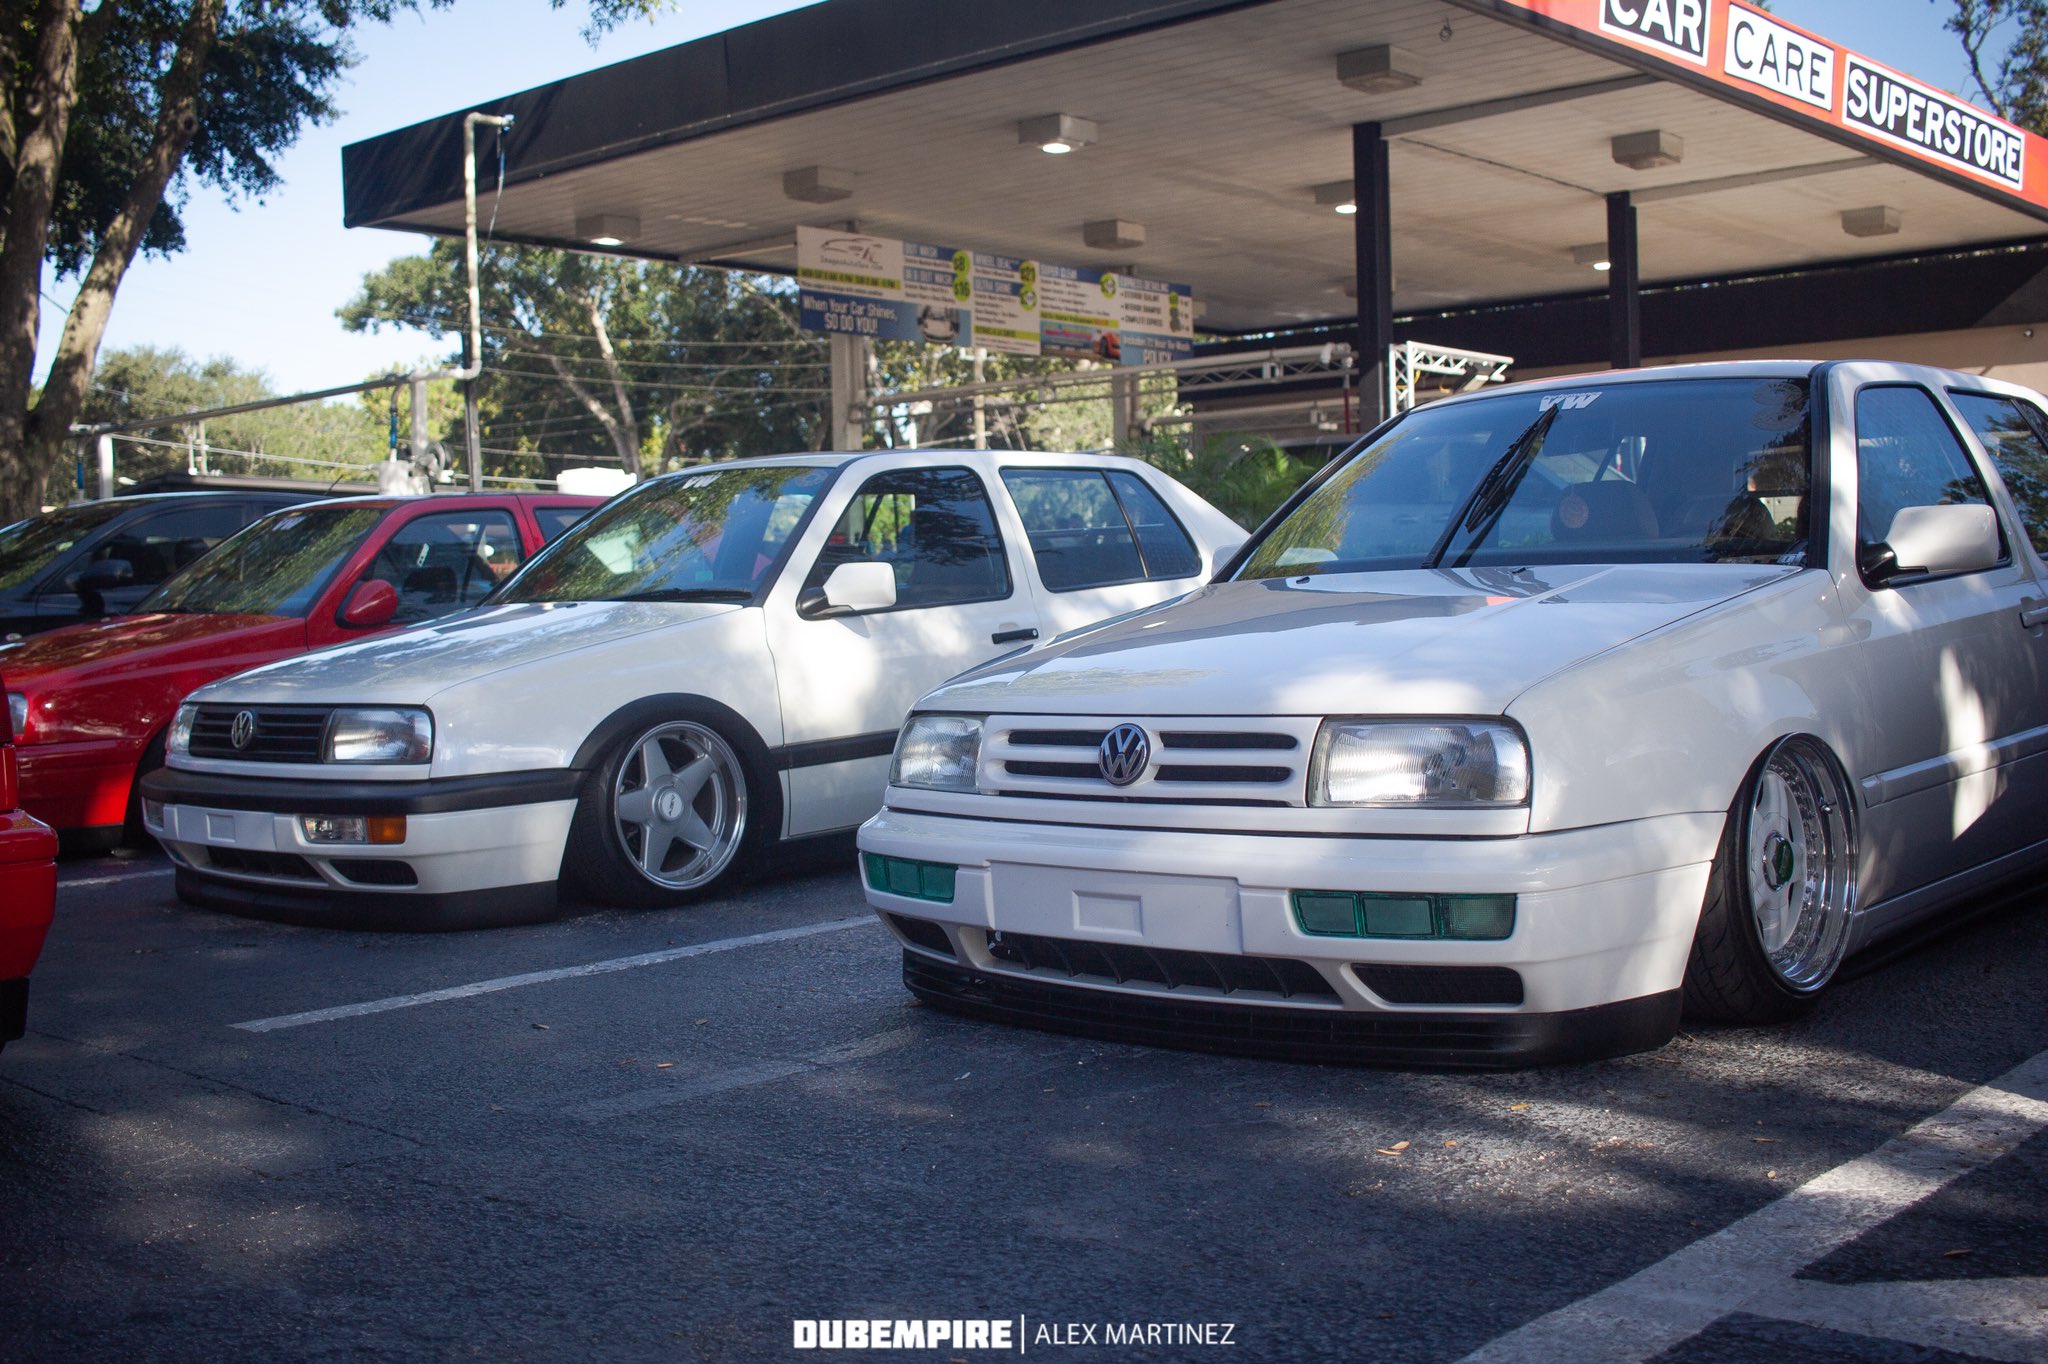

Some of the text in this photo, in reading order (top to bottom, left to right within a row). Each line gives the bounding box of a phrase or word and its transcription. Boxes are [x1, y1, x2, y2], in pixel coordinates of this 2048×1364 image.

[1733, 20, 1826, 99] CARE
[1847, 68, 2021, 180] SUPERSTORE
[802, 295, 828, 312] When
[829, 299, 848, 314] Your
[850, 301, 865, 315] Car
[824, 312, 839, 330] SO
[841, 314, 854, 331] DO
